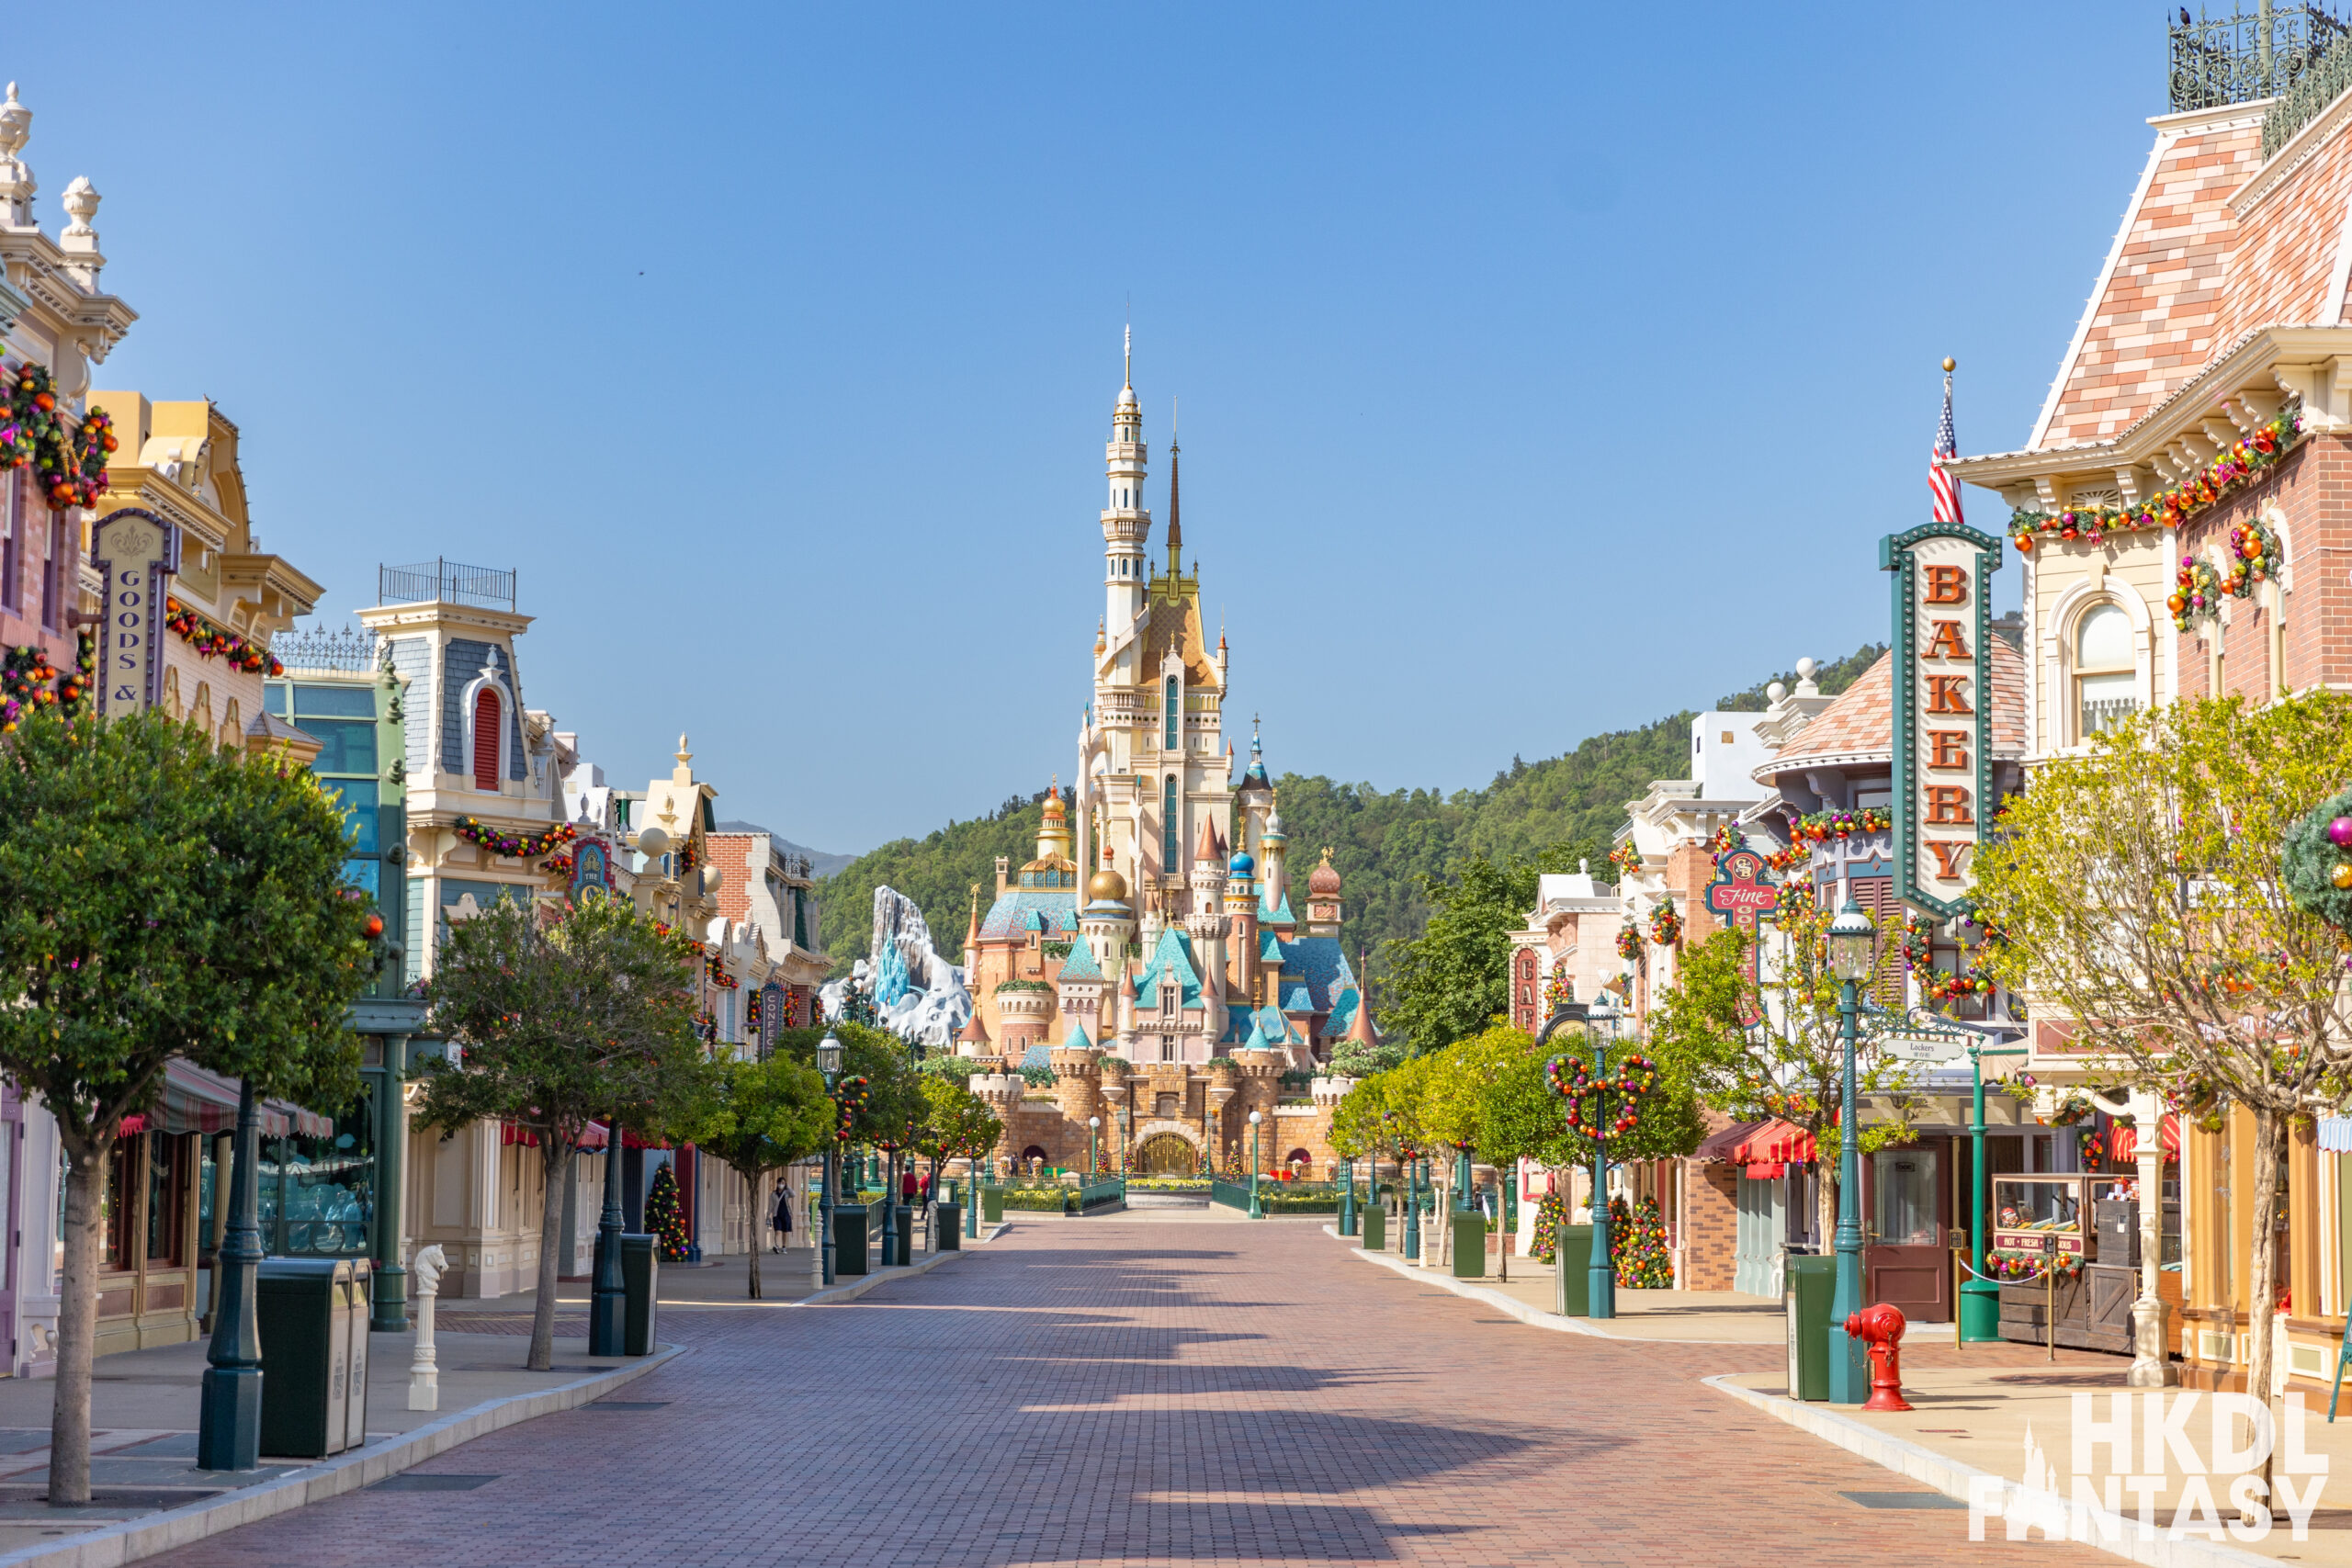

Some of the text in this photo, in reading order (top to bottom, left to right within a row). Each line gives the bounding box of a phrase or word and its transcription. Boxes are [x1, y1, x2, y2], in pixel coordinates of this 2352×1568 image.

[114, 570, 141, 701] GOODS &
[1920, 564, 1974, 880] BAKERY
[584, 873, 598, 881] THE
[1719, 888, 1771, 906] Fine
[1519, 959, 1534, 1030] CAF
[766, 995, 776, 1048] CONFEC
[1910, 1043, 1935, 1053] Lockers
[2004, 1237, 2016, 1247] HOT
[2021, 1237, 2039, 1247] FRESH
